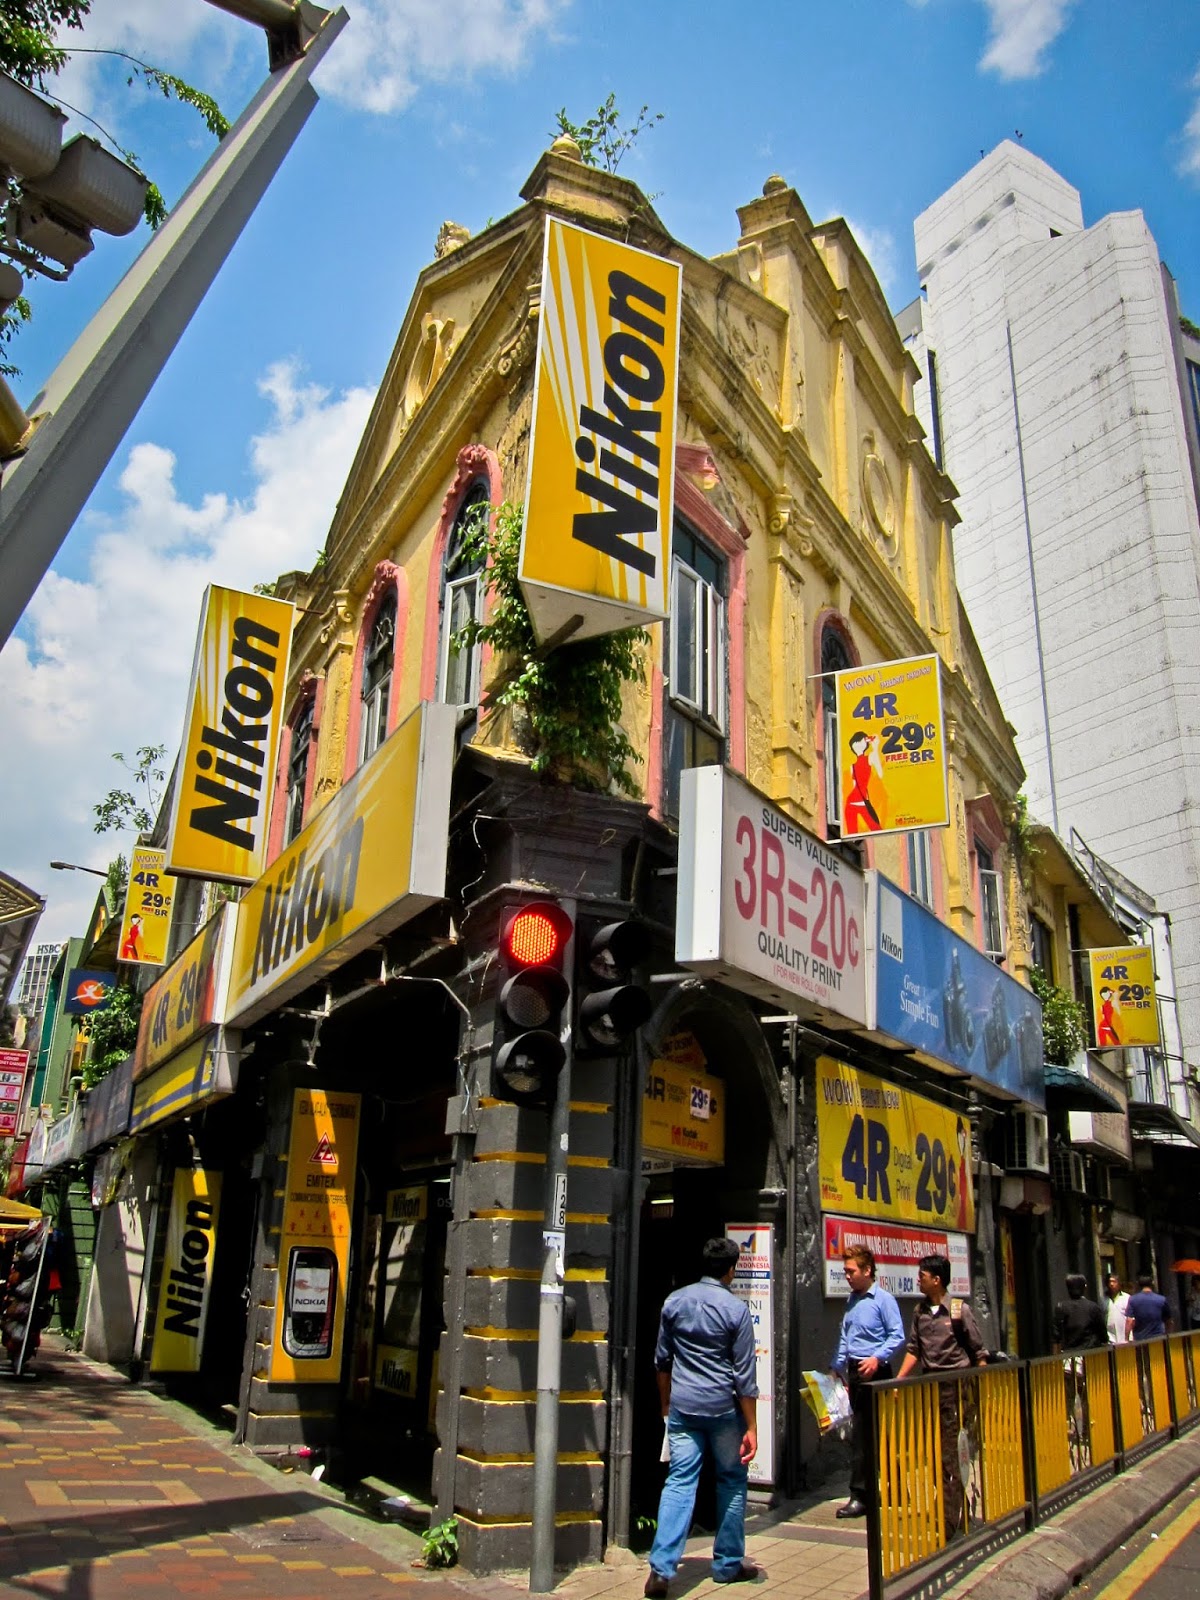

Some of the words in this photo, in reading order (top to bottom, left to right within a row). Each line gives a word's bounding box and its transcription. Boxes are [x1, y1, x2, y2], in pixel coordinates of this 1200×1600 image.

[572, 270, 666, 579] Nikon
[853, 692, 899, 721] 4R
[190, 616, 280, 852] Nikon
[886, 752, 908, 763] FREE
[909, 748, 935, 763] 8R
[762, 807, 803, 851] SUPER
[805, 838, 840, 877] VALUE
[133, 871, 159, 888] 4R
[154, 909, 168, 917] 8R
[251, 816, 365, 988] Nikon
[37, 943, 61, 955] HSBC
[881, 932, 902, 960] Nikon
[757, 930, 809, 975] QUALITY
[812, 958, 844, 991] PRINT
[1101, 965, 1129, 981] 4R
[903, 974, 920, 997] Great
[900, 989, 925, 1023] Simple
[925, 1004, 939, 1029] Fun
[1136, 1001, 1151, 1009] 8R
[152, 990, 170, 1050] 4R
[842, 1113, 892, 1205] 4R
[894, 1145, 913, 1175] Digital
[306, 1173, 336, 1189] EMITEX
[895, 1178, 912, 1202] Print
[392, 1192, 420, 1219] Nikon
[163, 1200, 214, 1338] Nikon
[903, 1277, 914, 1292] BCA
[295, 1298, 326, 1306] NOKIA
[381, 1359, 411, 1392] Nikon
